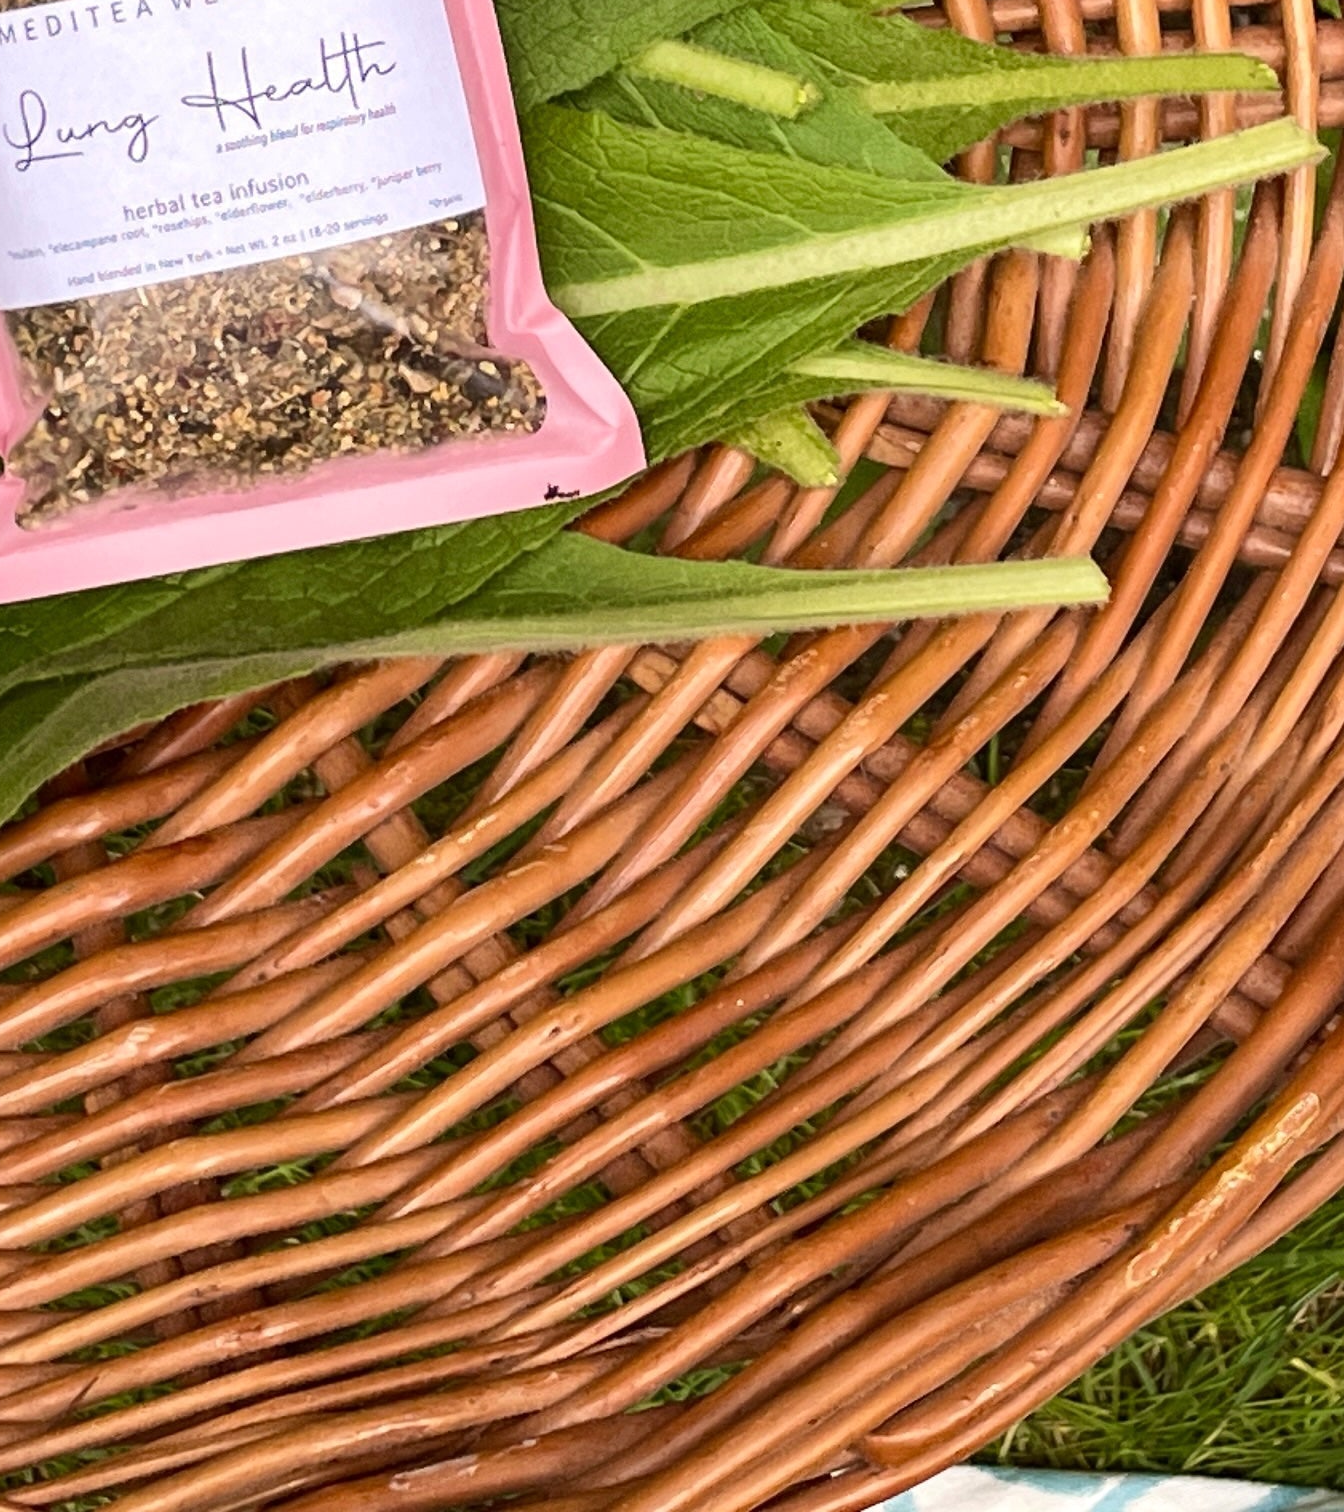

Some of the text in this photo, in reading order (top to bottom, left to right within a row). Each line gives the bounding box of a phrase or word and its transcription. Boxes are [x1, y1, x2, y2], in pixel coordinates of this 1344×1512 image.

[3, 32, 396, 171] Lung Health
[123, 172, 310, 222] herbal tea infusion
[344, 212, 389, 230] servings
